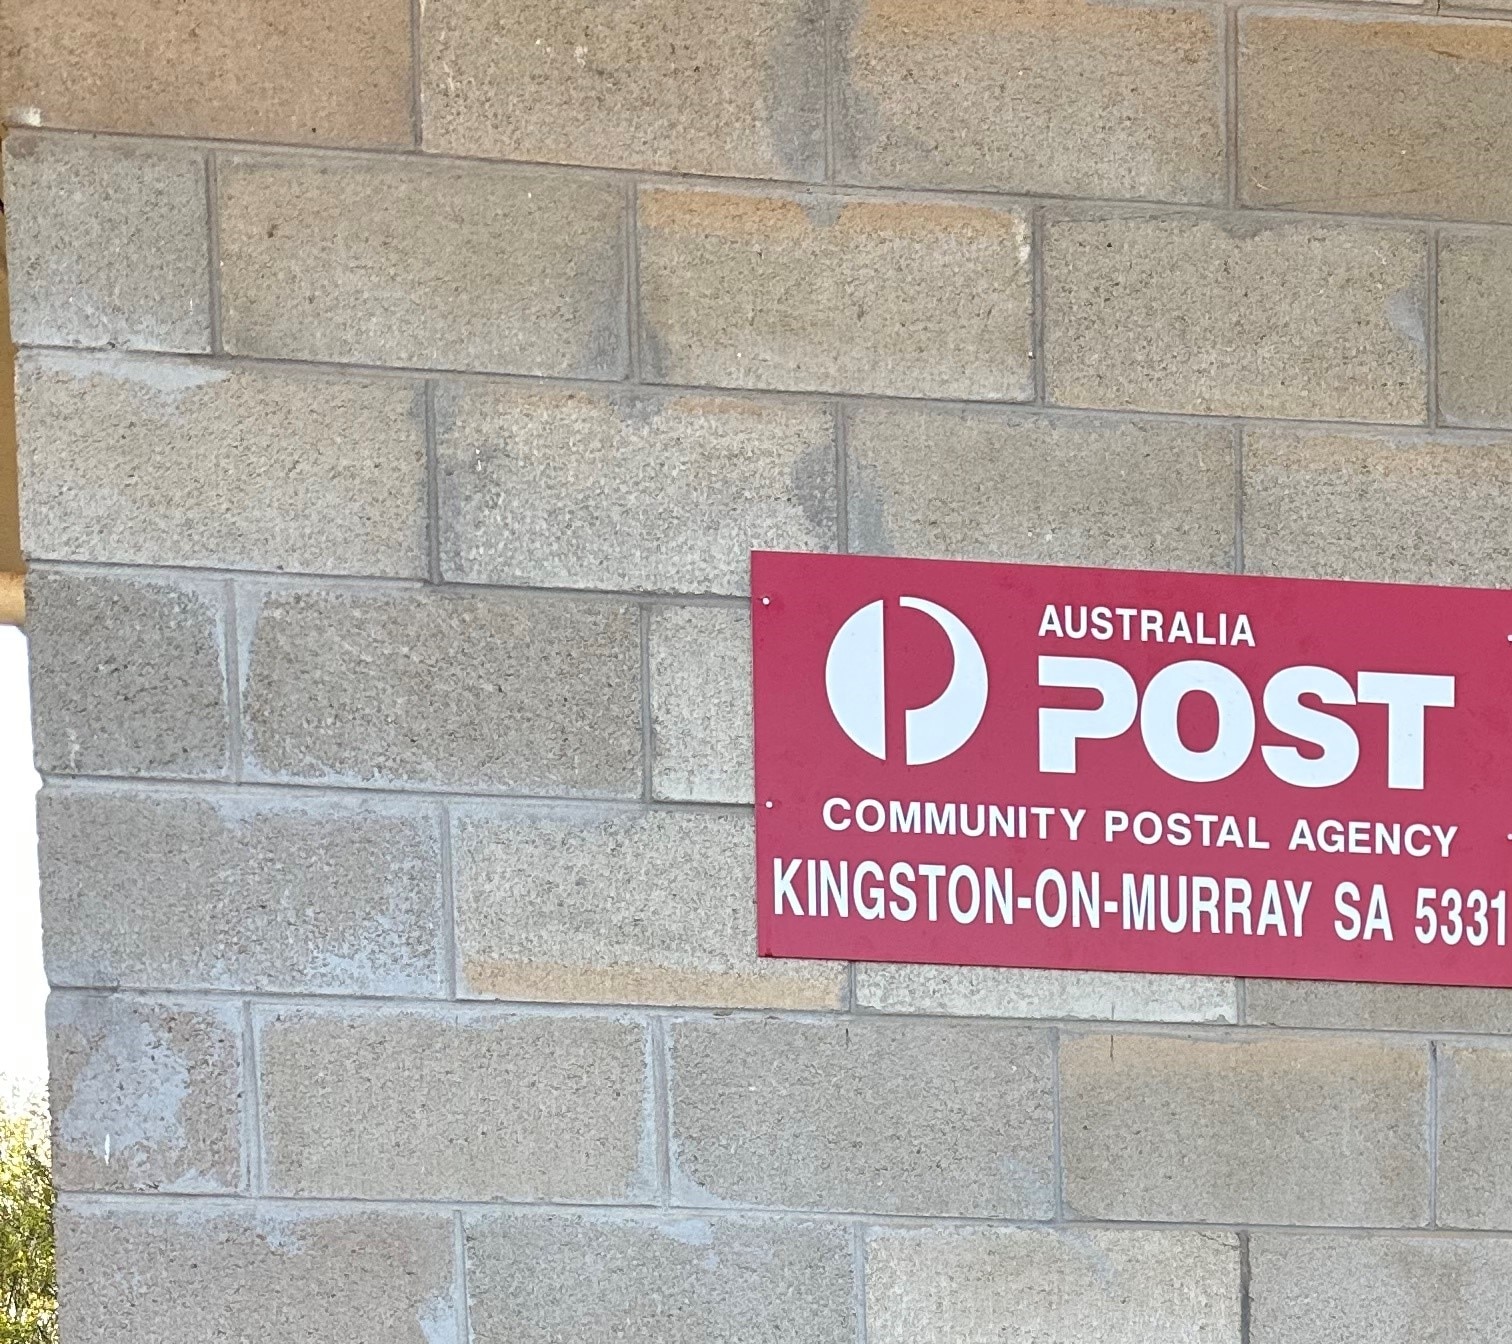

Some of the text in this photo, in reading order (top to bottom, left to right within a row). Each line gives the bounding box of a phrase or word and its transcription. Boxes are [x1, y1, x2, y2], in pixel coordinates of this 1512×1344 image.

[1038, 604, 1257, 648] AUSTRALIA
[1038, 655, 1456, 791] POST
[822, 798, 1459, 858] COMMUNITY POSTAL AGENCY
[772, 858, 1508, 946] KINGSTON-ON-MURRAY SA 5331
